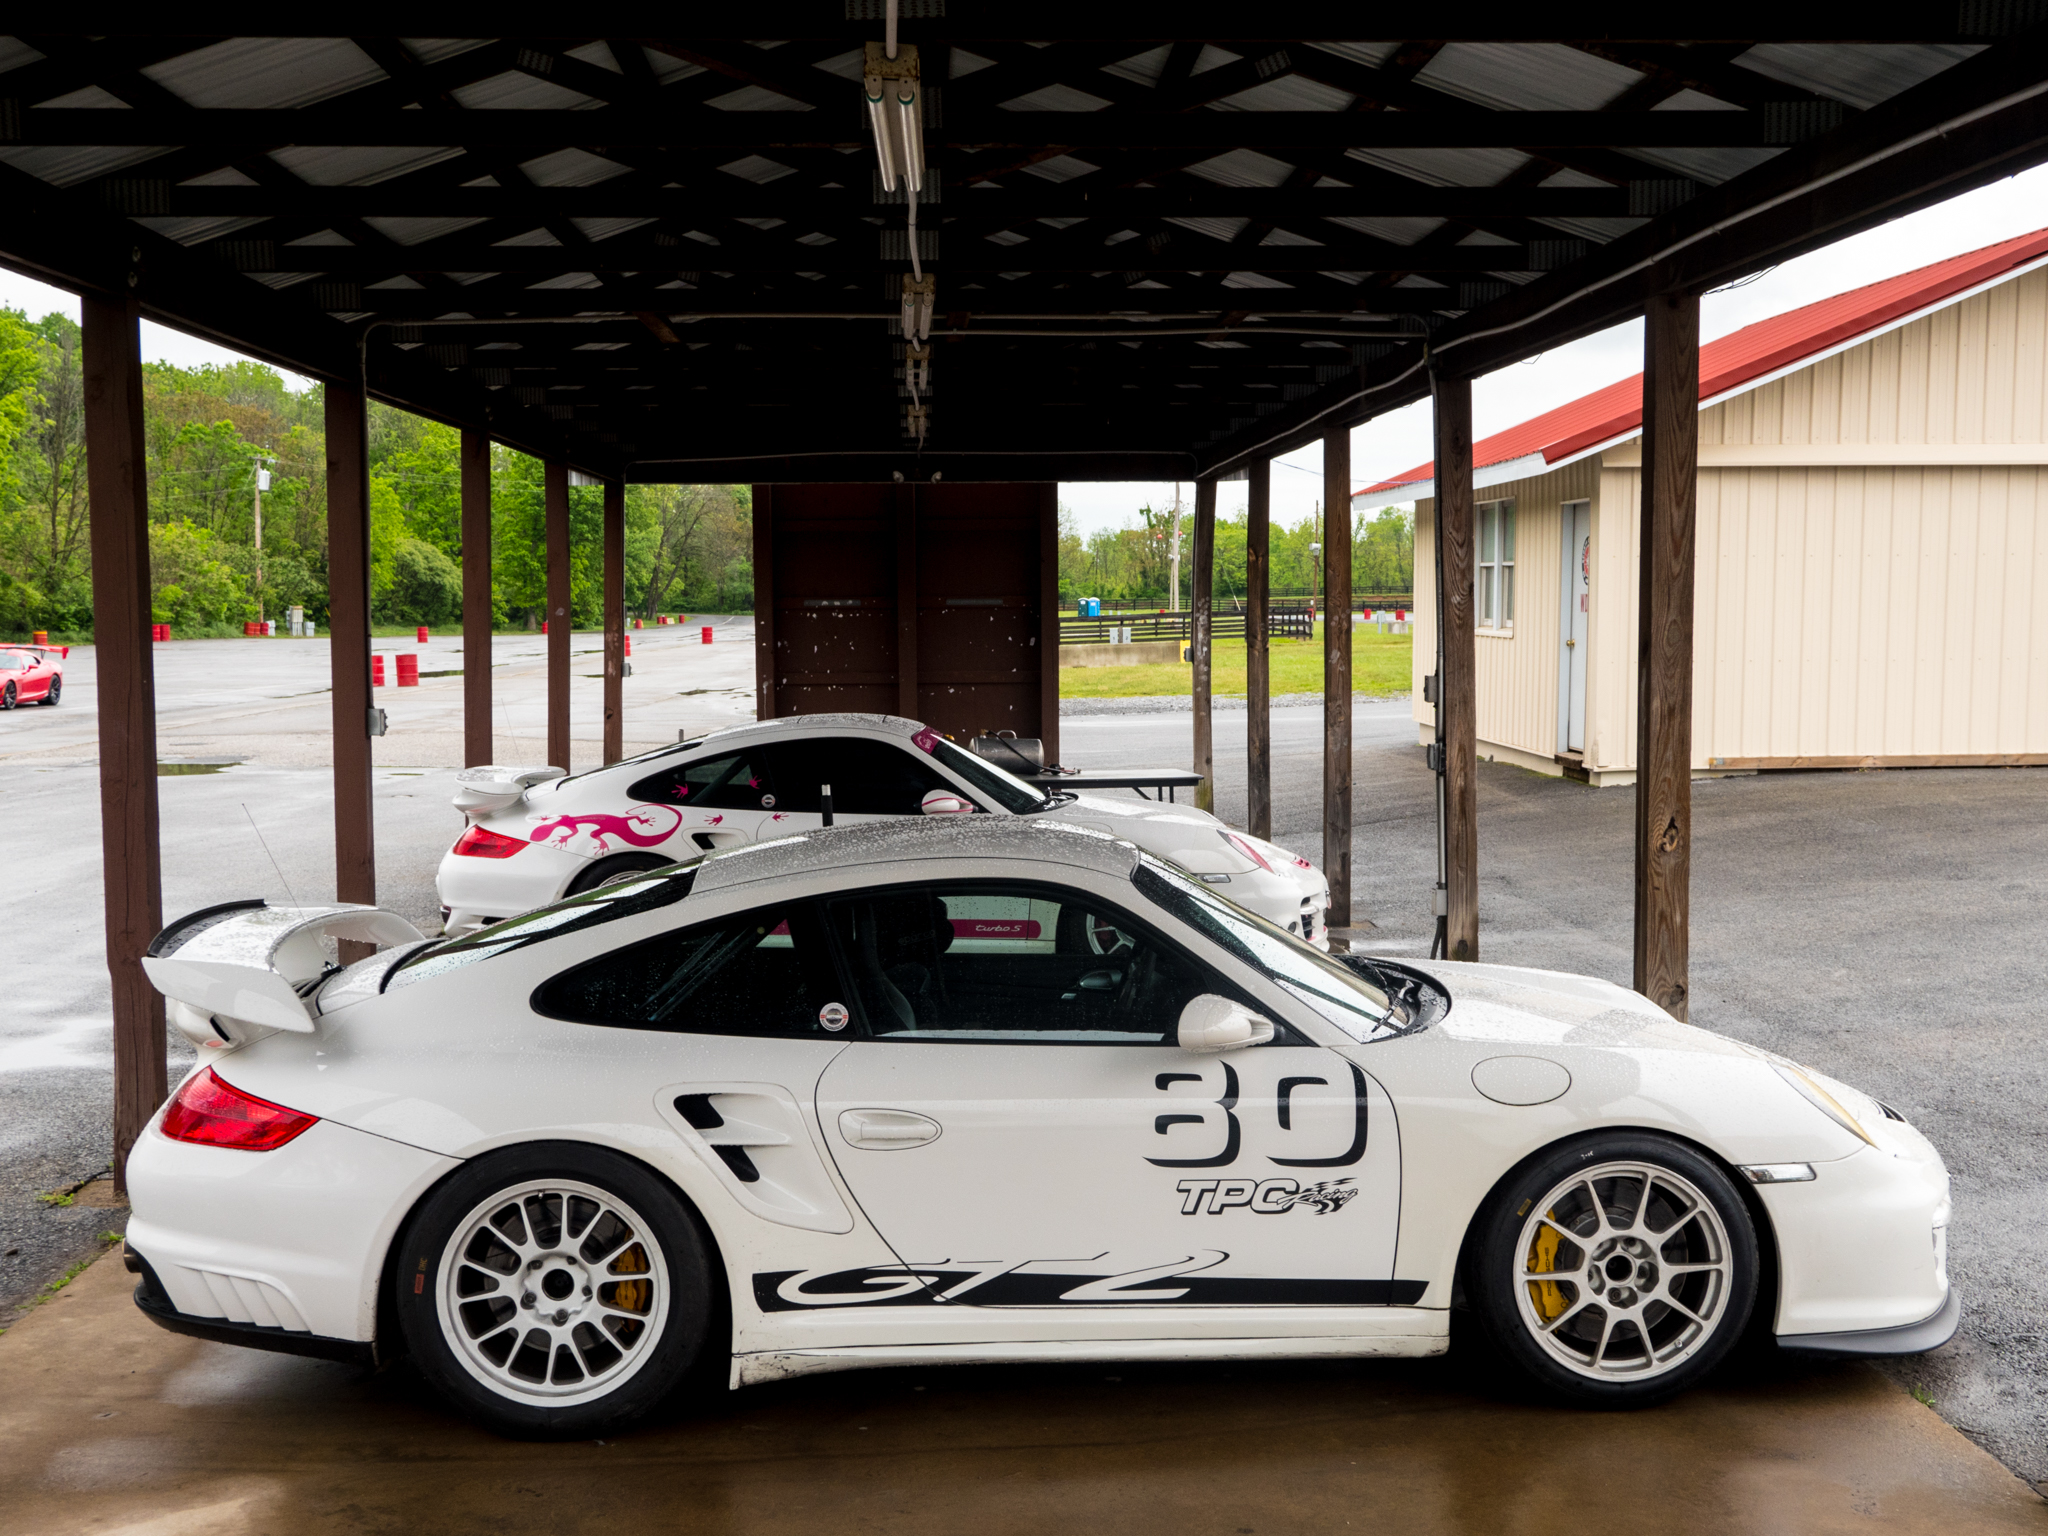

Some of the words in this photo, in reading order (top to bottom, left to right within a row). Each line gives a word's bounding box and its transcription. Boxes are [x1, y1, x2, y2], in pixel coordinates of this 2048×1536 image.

[975, 924, 1009, 932] turbo
[1010, 924, 1022, 932] S
[1176, 1178, 1301, 1215] TPC
[1276, 1188, 1359, 1210] Racing
[1544, 1246, 1552, 1297] POSCHE
